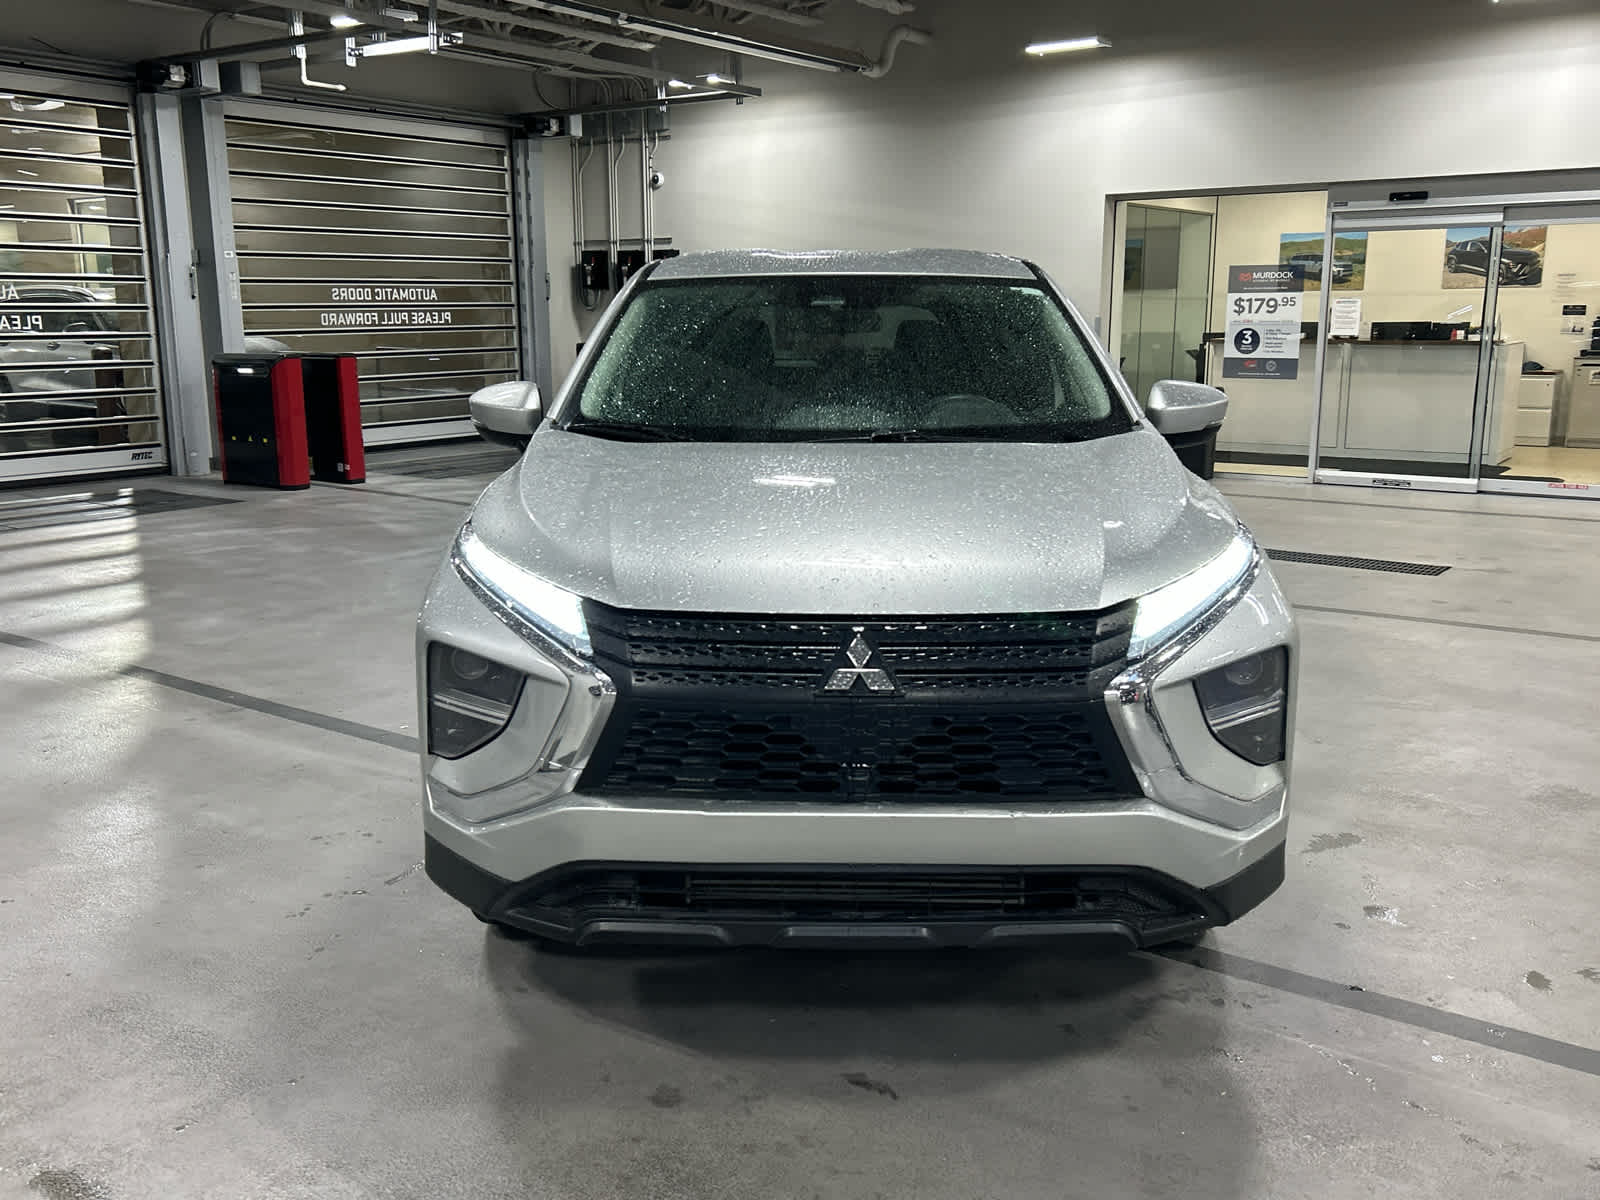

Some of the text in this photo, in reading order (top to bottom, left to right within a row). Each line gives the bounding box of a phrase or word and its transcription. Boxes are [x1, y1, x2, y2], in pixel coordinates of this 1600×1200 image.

[1252, 271, 1293, 279] MURDOCK
[1233, 296, 1297, 316] $179.95
[1241, 330, 1253, 345] 3
